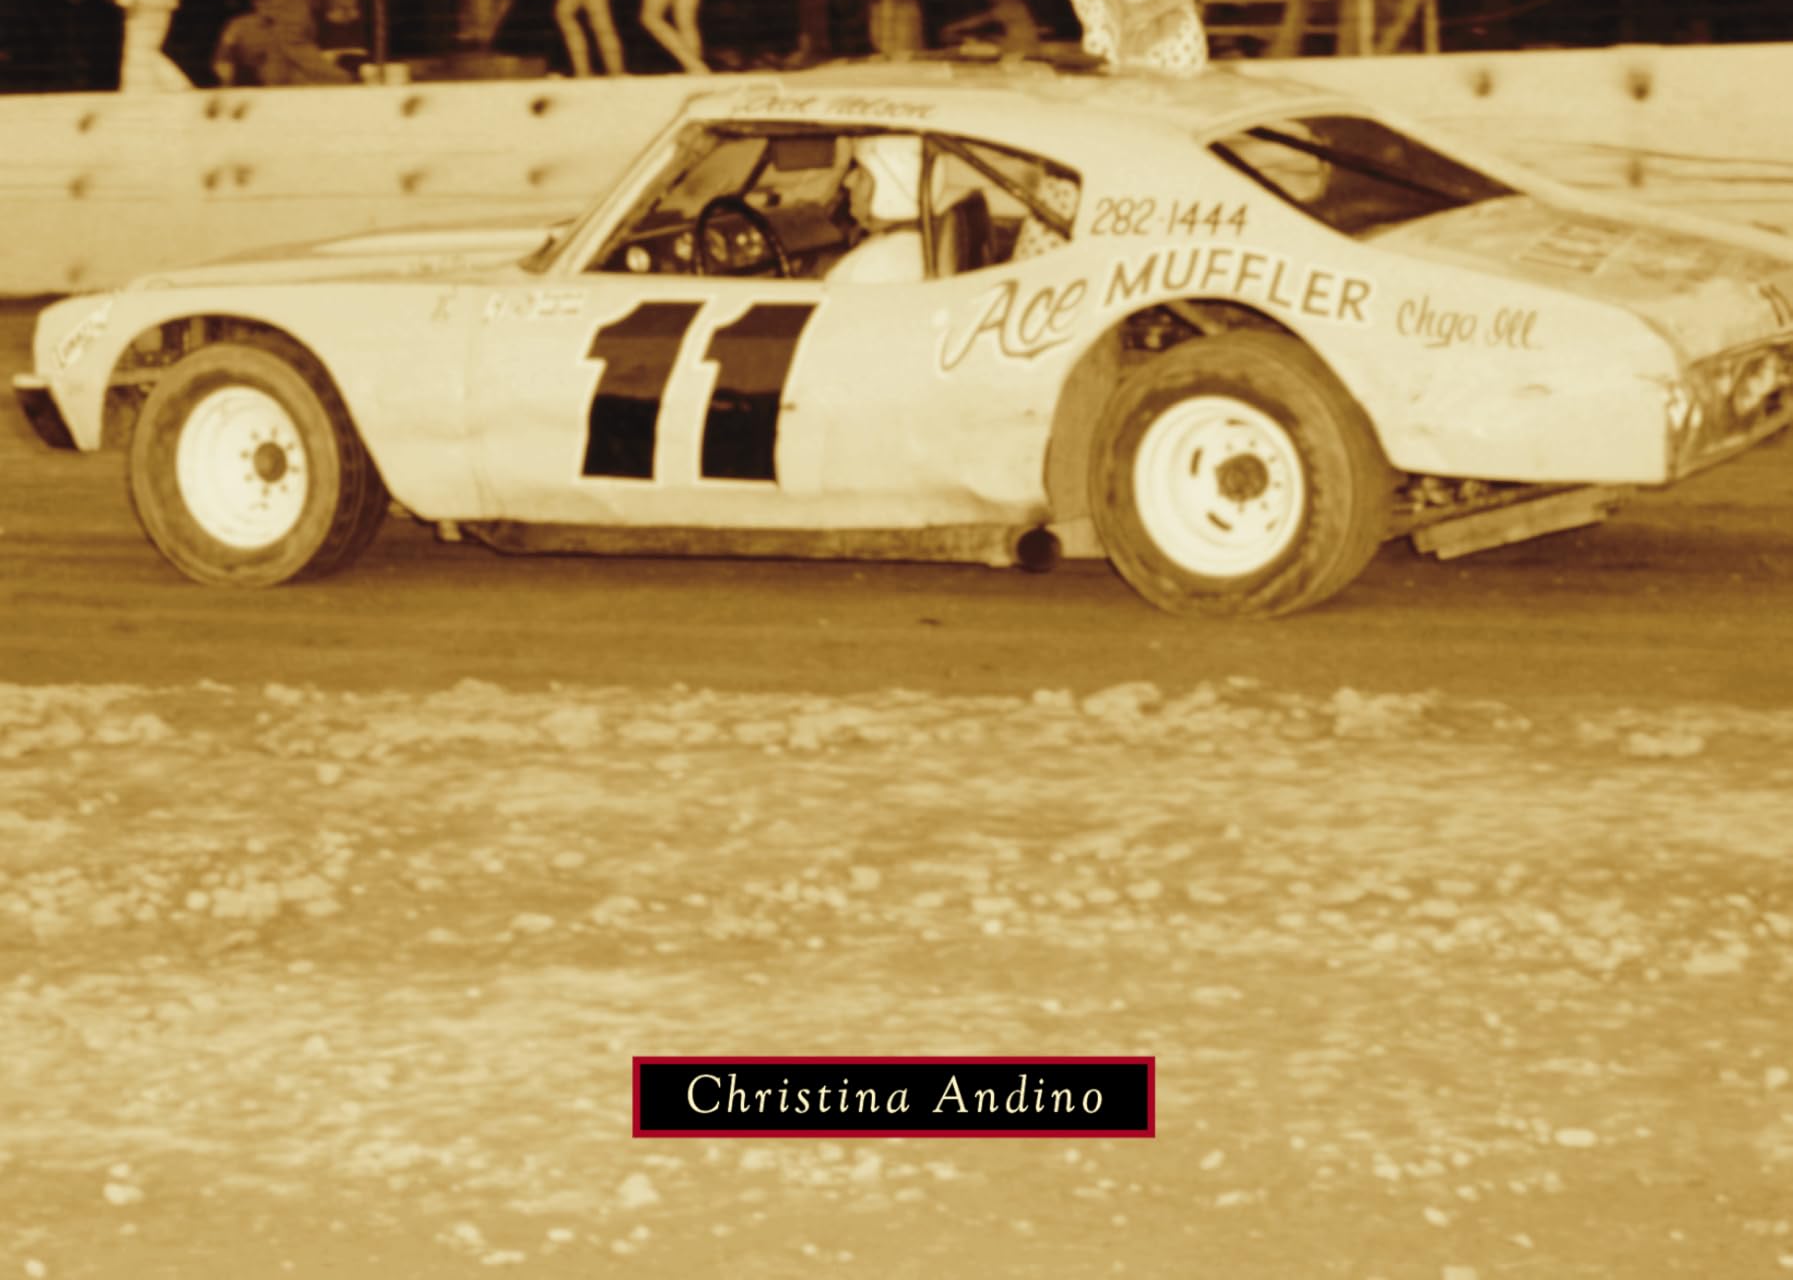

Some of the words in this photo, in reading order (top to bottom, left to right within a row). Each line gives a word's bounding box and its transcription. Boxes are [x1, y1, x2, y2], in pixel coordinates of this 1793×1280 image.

[941, 278, 1088, 372] Ace
[1104, 247, 1371, 321] MUFFLER
[580, 300, 820, 486] 11
